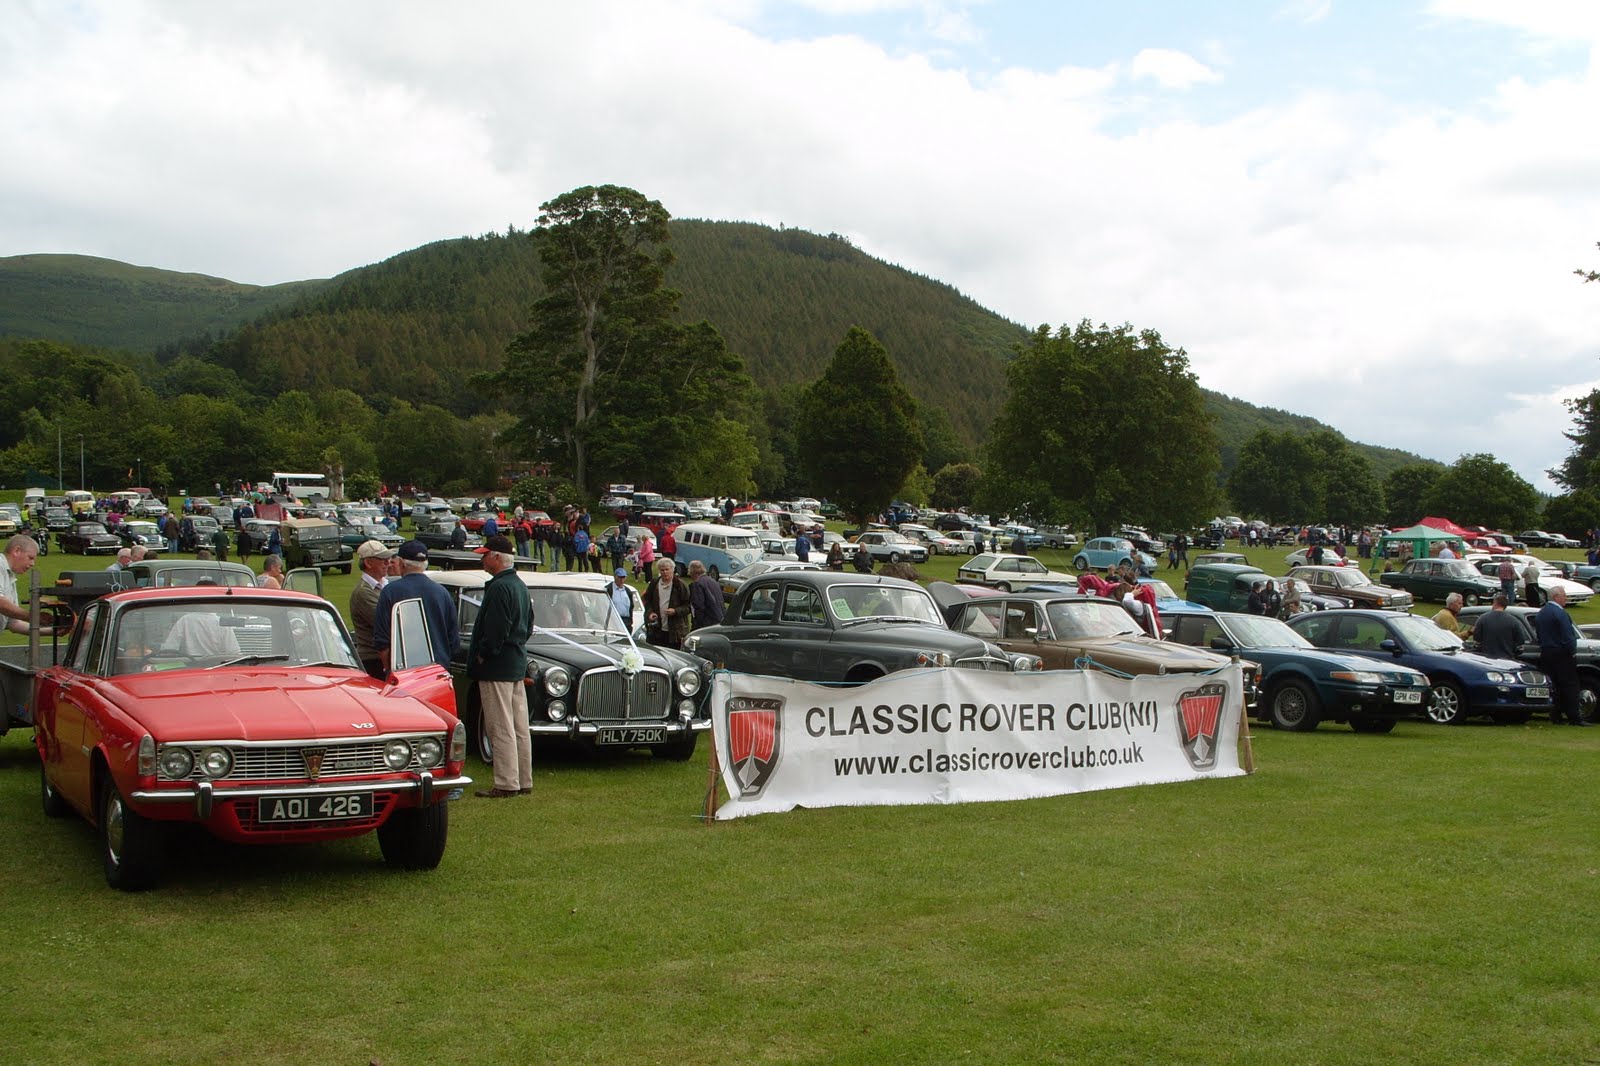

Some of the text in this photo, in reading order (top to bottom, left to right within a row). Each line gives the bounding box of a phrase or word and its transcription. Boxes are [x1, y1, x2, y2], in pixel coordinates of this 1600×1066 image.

[729, 700, 780, 709] ROVER
[1395, 692, 1407, 701] GPM
[805, 701, 1159, 737] CLASSIC ROVER CLUB(NI)
[602, 729, 662, 742] HLY 750K
[834, 742, 1144, 776] www.classicroverclub.co.uk
[272, 796, 361, 819] AOI 426
